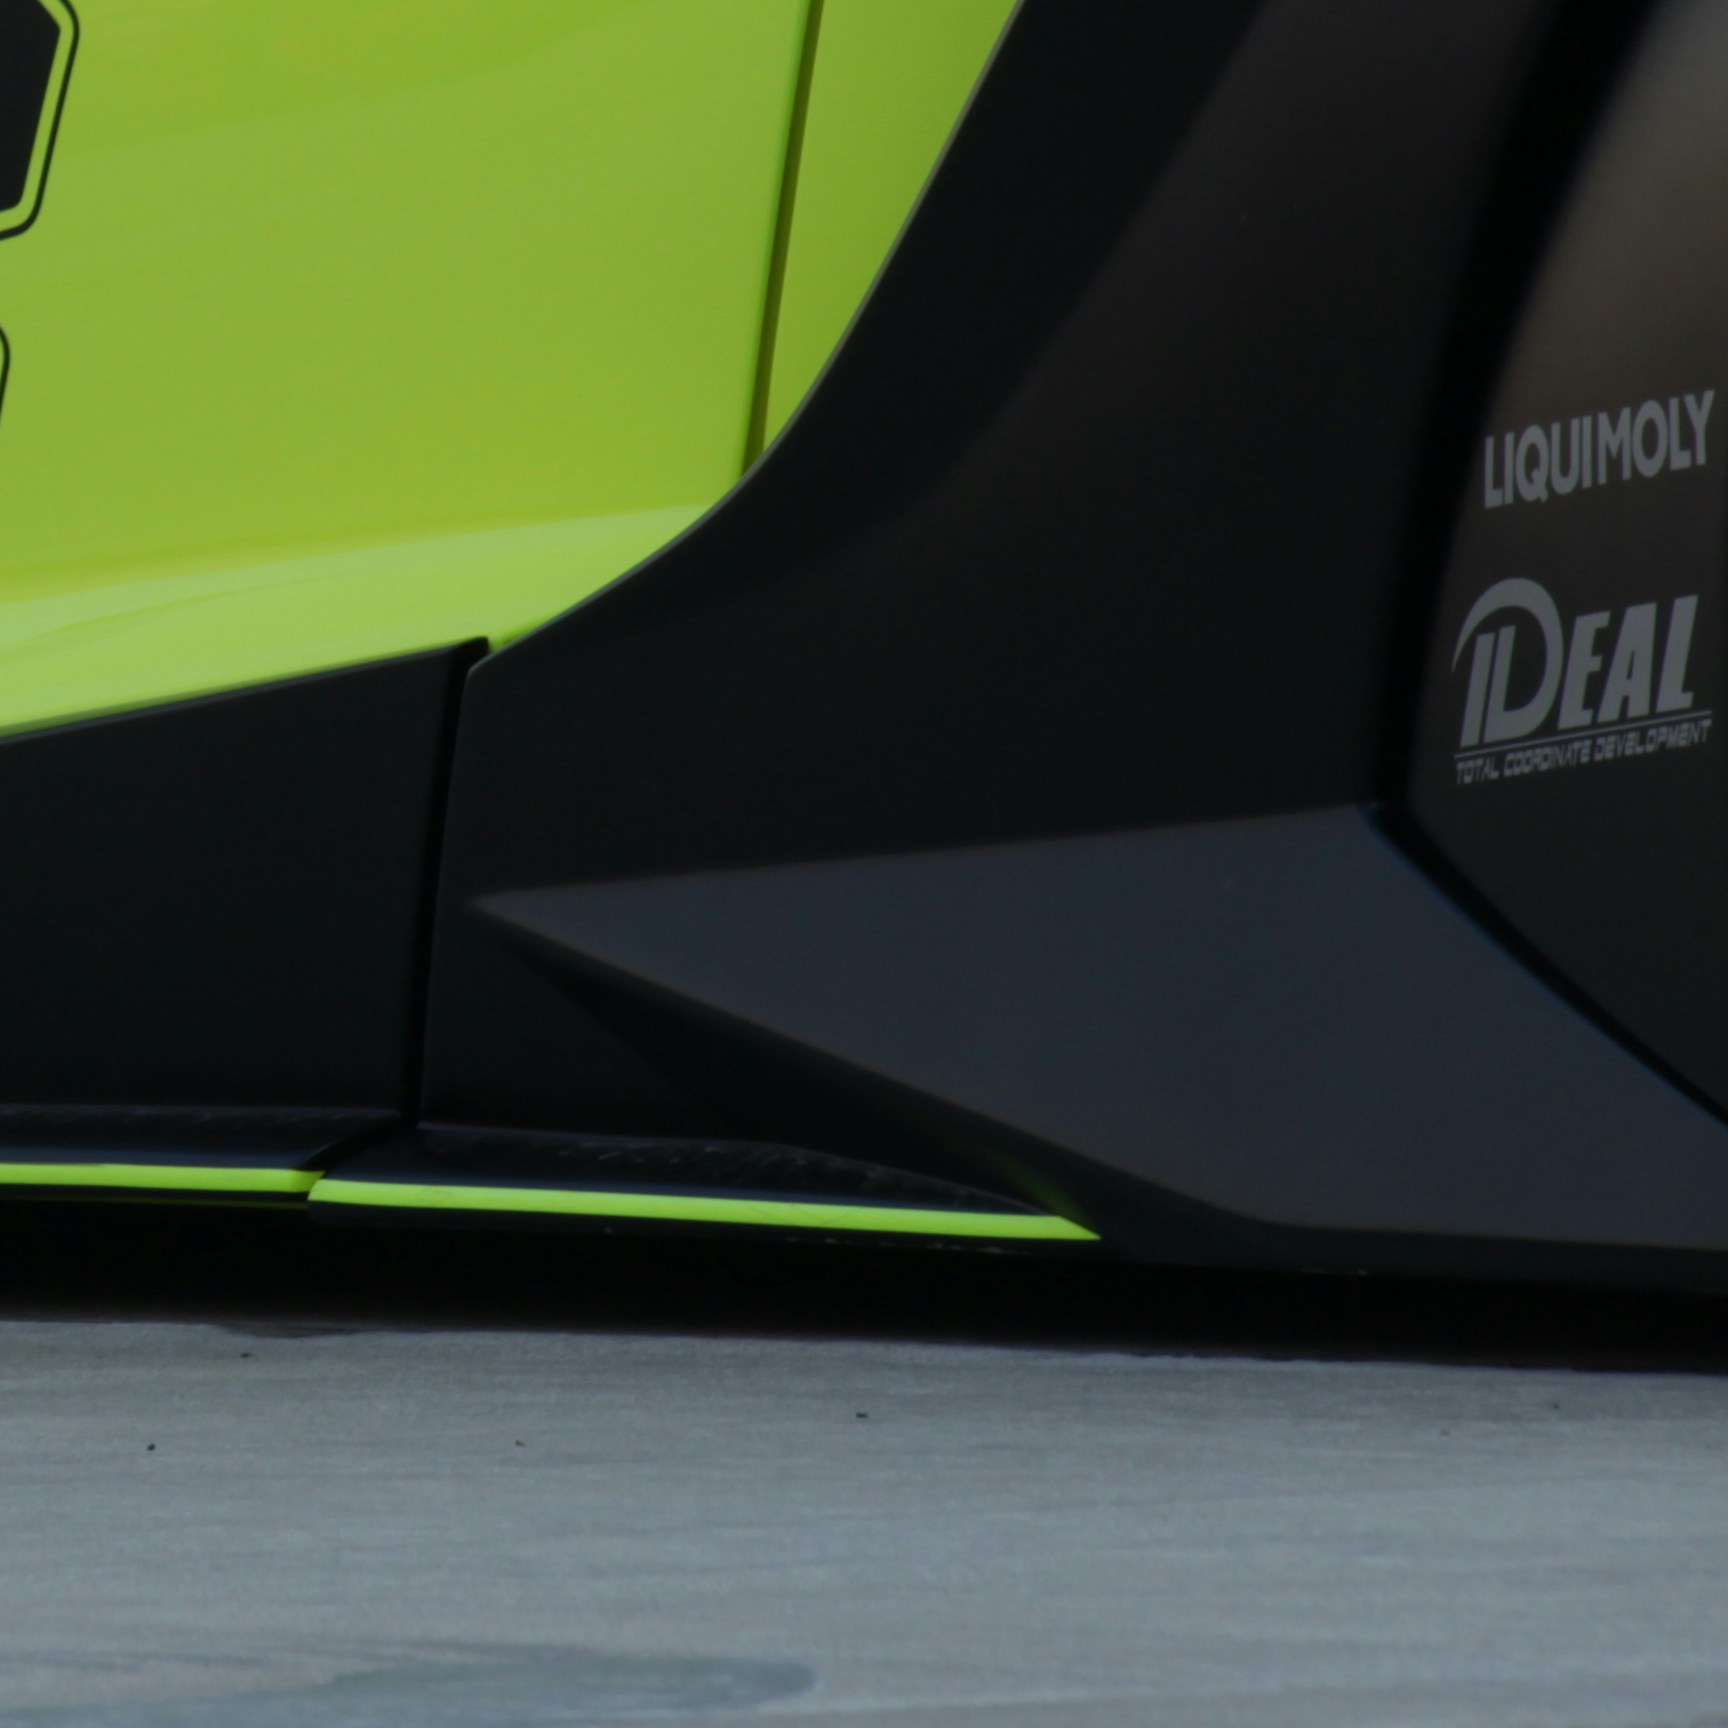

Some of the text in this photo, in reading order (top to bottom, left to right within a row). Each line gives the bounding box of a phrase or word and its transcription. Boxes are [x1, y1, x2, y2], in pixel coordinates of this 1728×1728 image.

[1451, 577, 1699, 747] IDEAL
[1456, 755, 1499, 784] TOTAL
[1594, 719, 1712, 762] DEVELOPMENT
